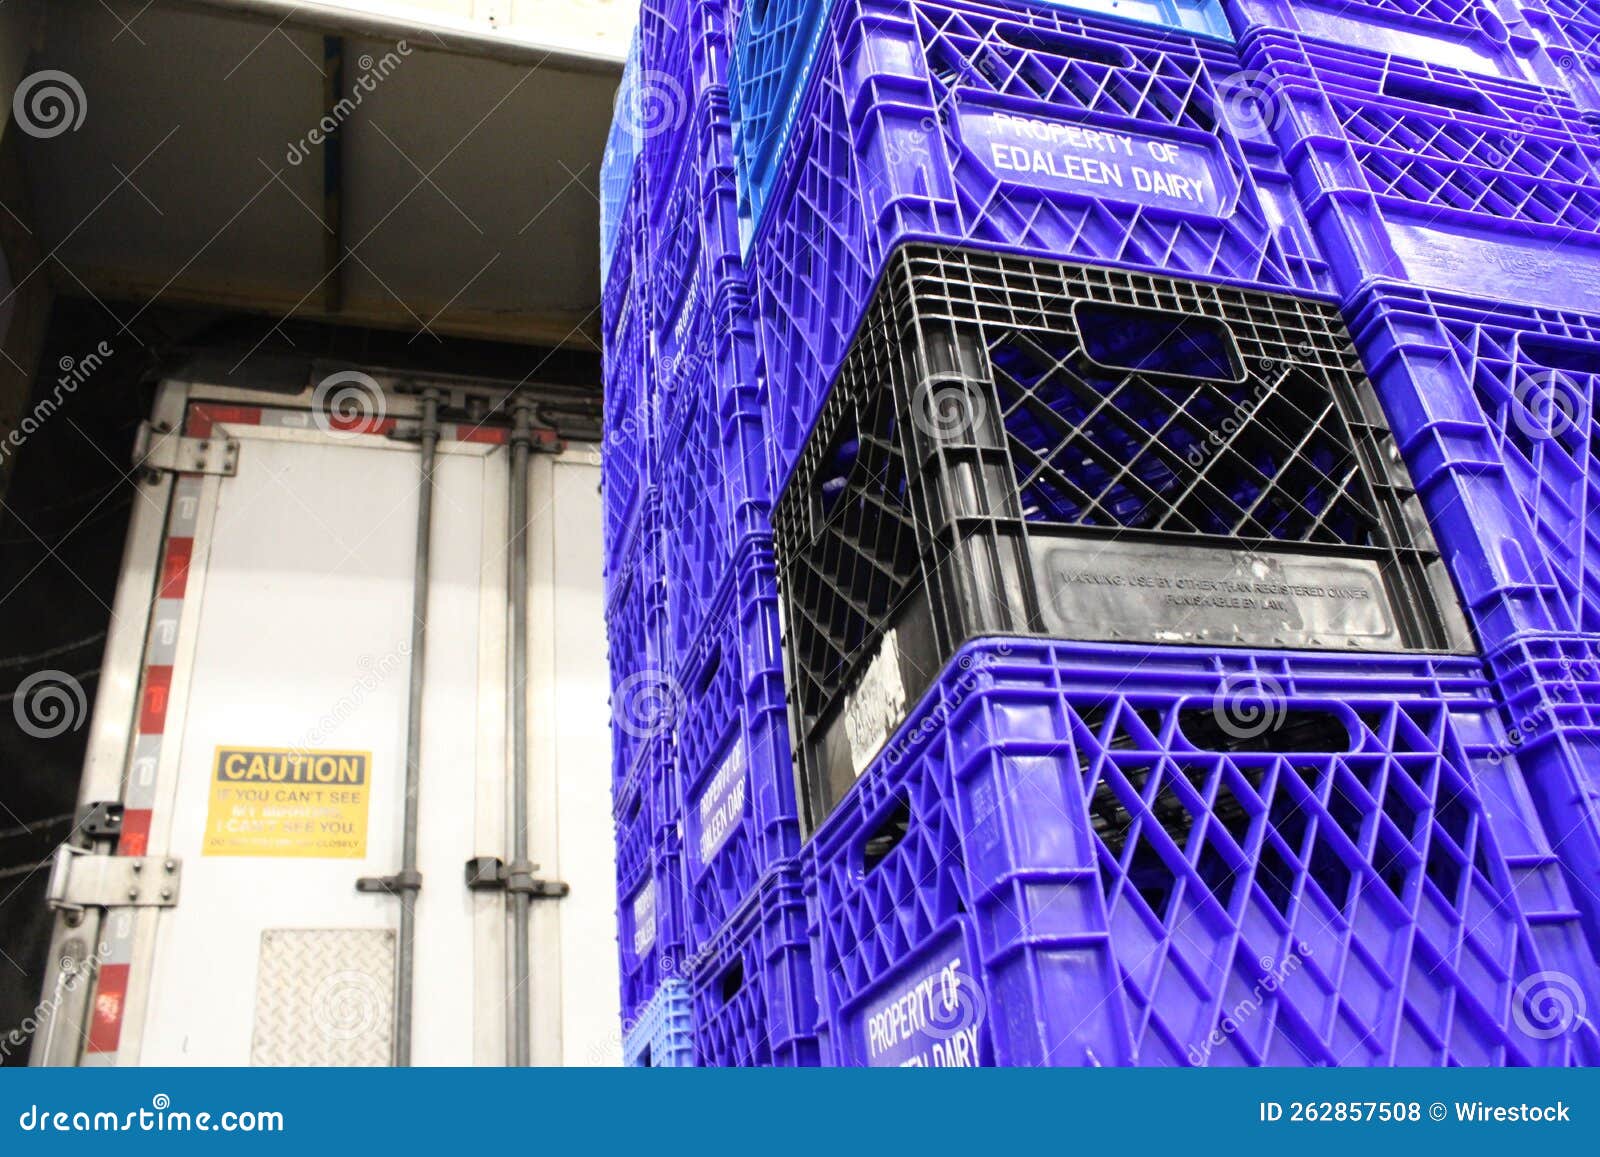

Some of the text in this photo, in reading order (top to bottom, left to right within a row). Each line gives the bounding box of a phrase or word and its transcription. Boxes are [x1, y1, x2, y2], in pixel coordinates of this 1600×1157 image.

[992, 112, 1180, 165] PROPERTY OF
[990, 143, 1204, 203] EDALEEN DAIRY
[1128, 576, 1155, 589] USE
[1156, 577, 1172, 589] BY
[1175, 578, 1217, 592] OTHER
[1218, 581, 1251, 594] THAN
[1254, 583, 1326, 598] REGISTERED
[1328, 586, 1370, 601] OWNER
[1242, 599, 1258, 610] BY
[224, 753, 359, 783] CAUTION
[216, 788, 361, 805] IF YOU CAN'T SEE
[281, 821, 315, 834] SEE
[868, 957, 961, 1059] PROPERTY OF
